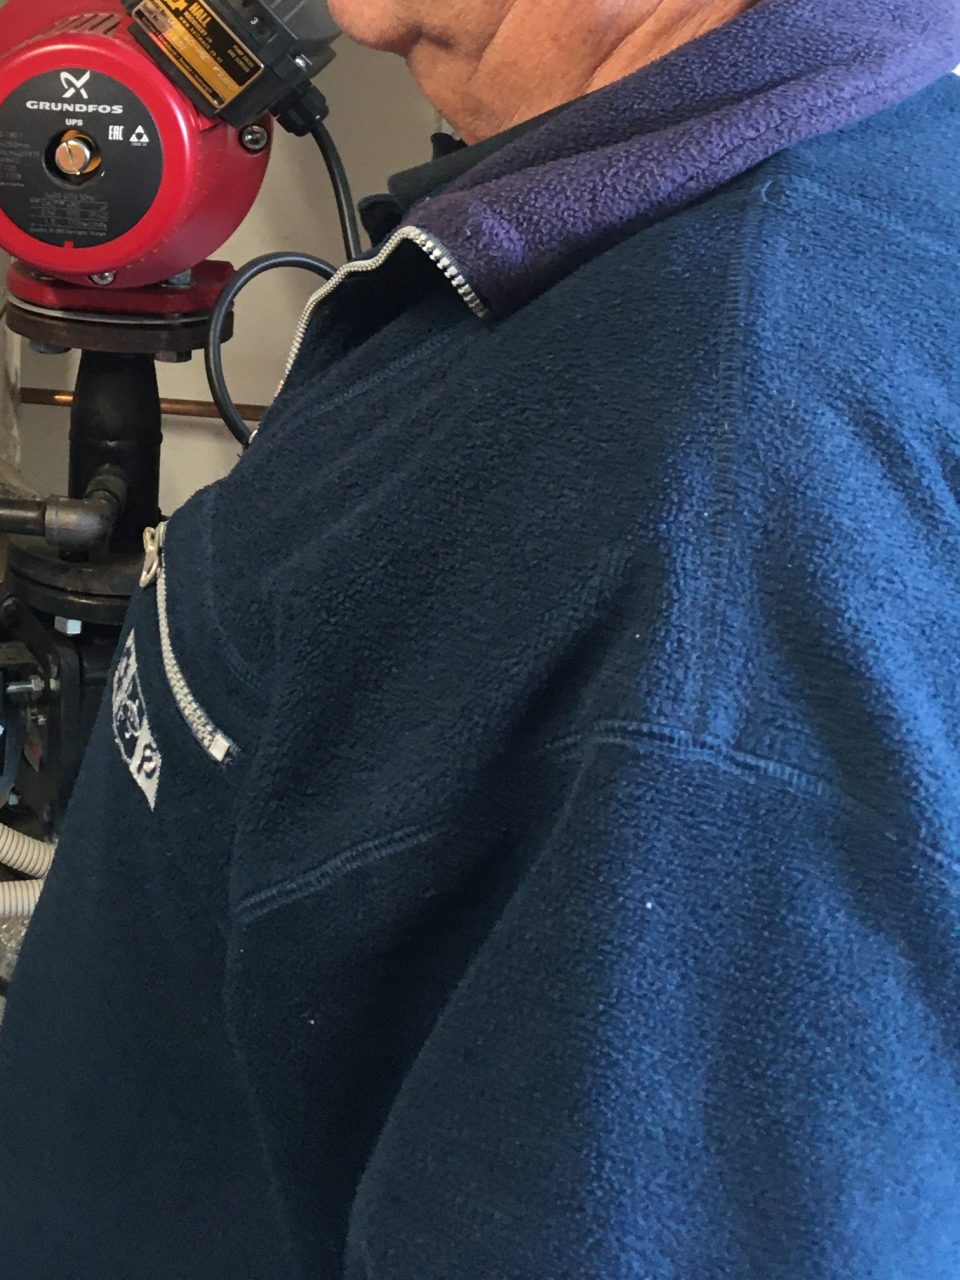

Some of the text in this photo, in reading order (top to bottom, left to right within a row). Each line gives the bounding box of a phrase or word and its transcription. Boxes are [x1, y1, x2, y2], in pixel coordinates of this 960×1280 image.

[187, 1, 213, 27] HALL
[250, 17, 259, 26] 3
[25, 100, 124, 115] GRUNDFOS
[65, 118, 84, 127] UPS
[108, 125, 124, 141] EAC
